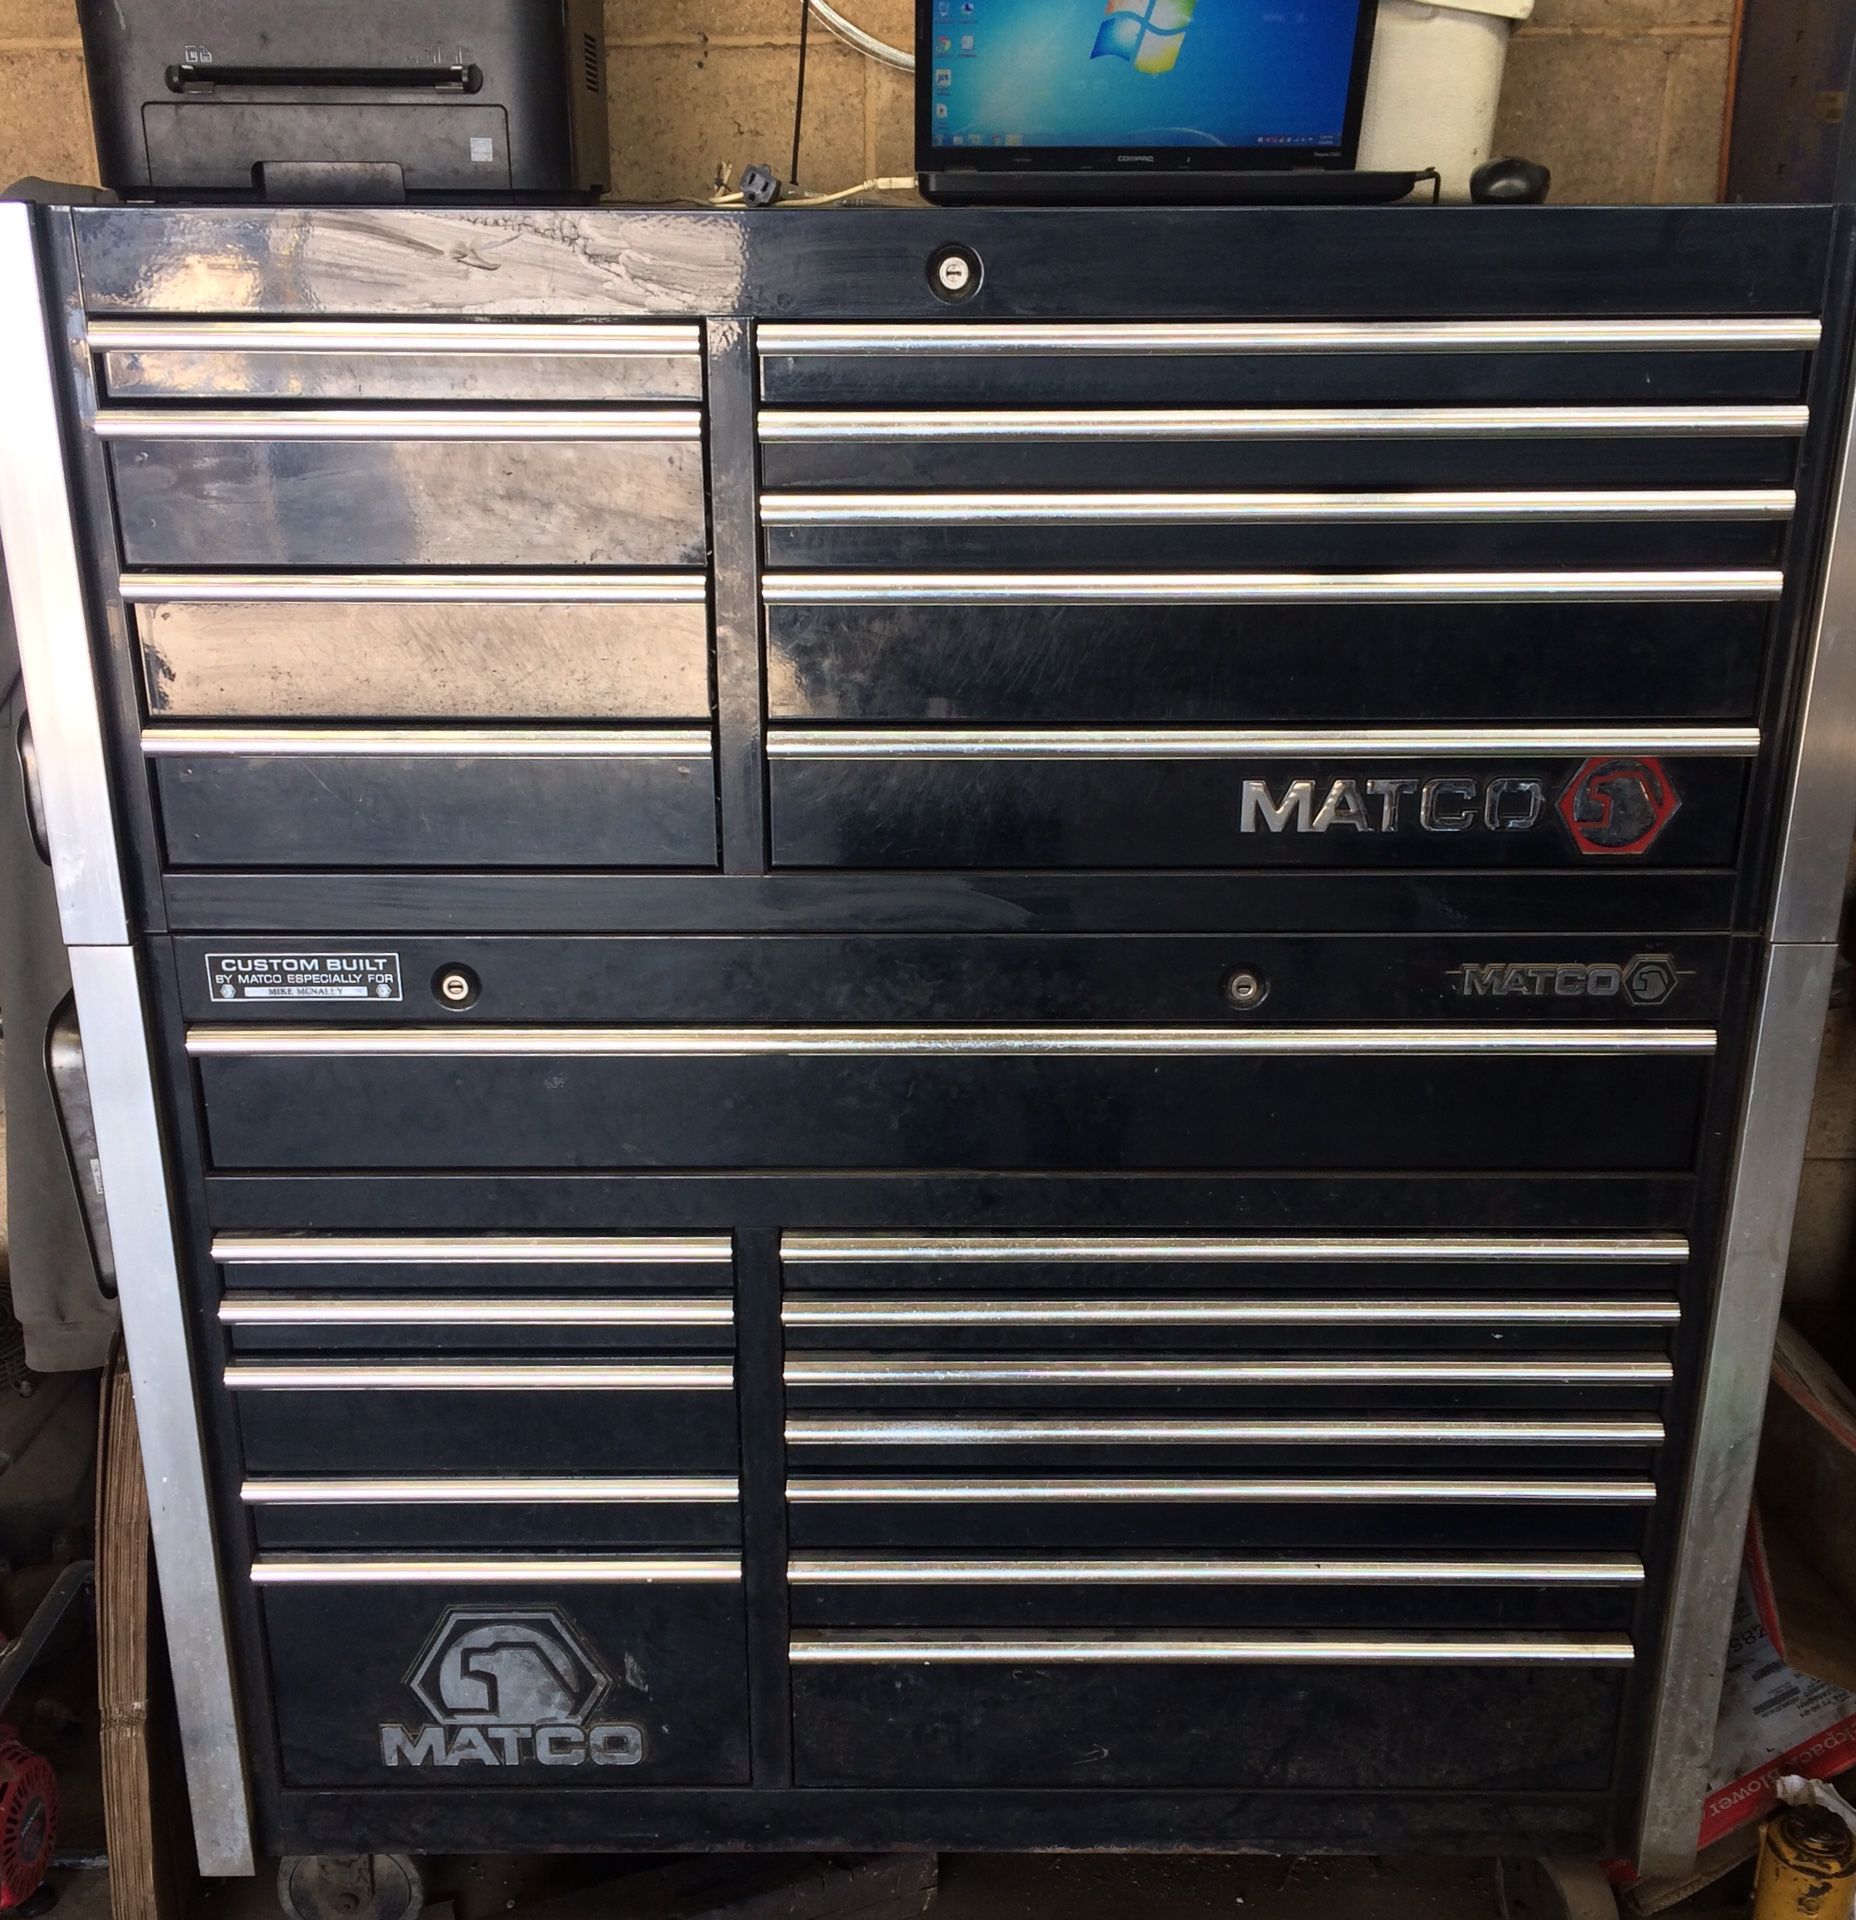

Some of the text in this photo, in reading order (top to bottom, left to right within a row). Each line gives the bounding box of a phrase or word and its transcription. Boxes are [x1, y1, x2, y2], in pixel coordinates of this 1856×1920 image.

[1240, 777, 1546, 833] MATCO
[221, 957, 388, 972] CUSTOM BUILT
[215, 974, 394, 985] BY MATCO ESPECIALLY FOR
[268, 986, 294, 996] MIKE
[1462, 964, 1621, 996] MATCO
[379, 1724, 646, 1767] MATCO
